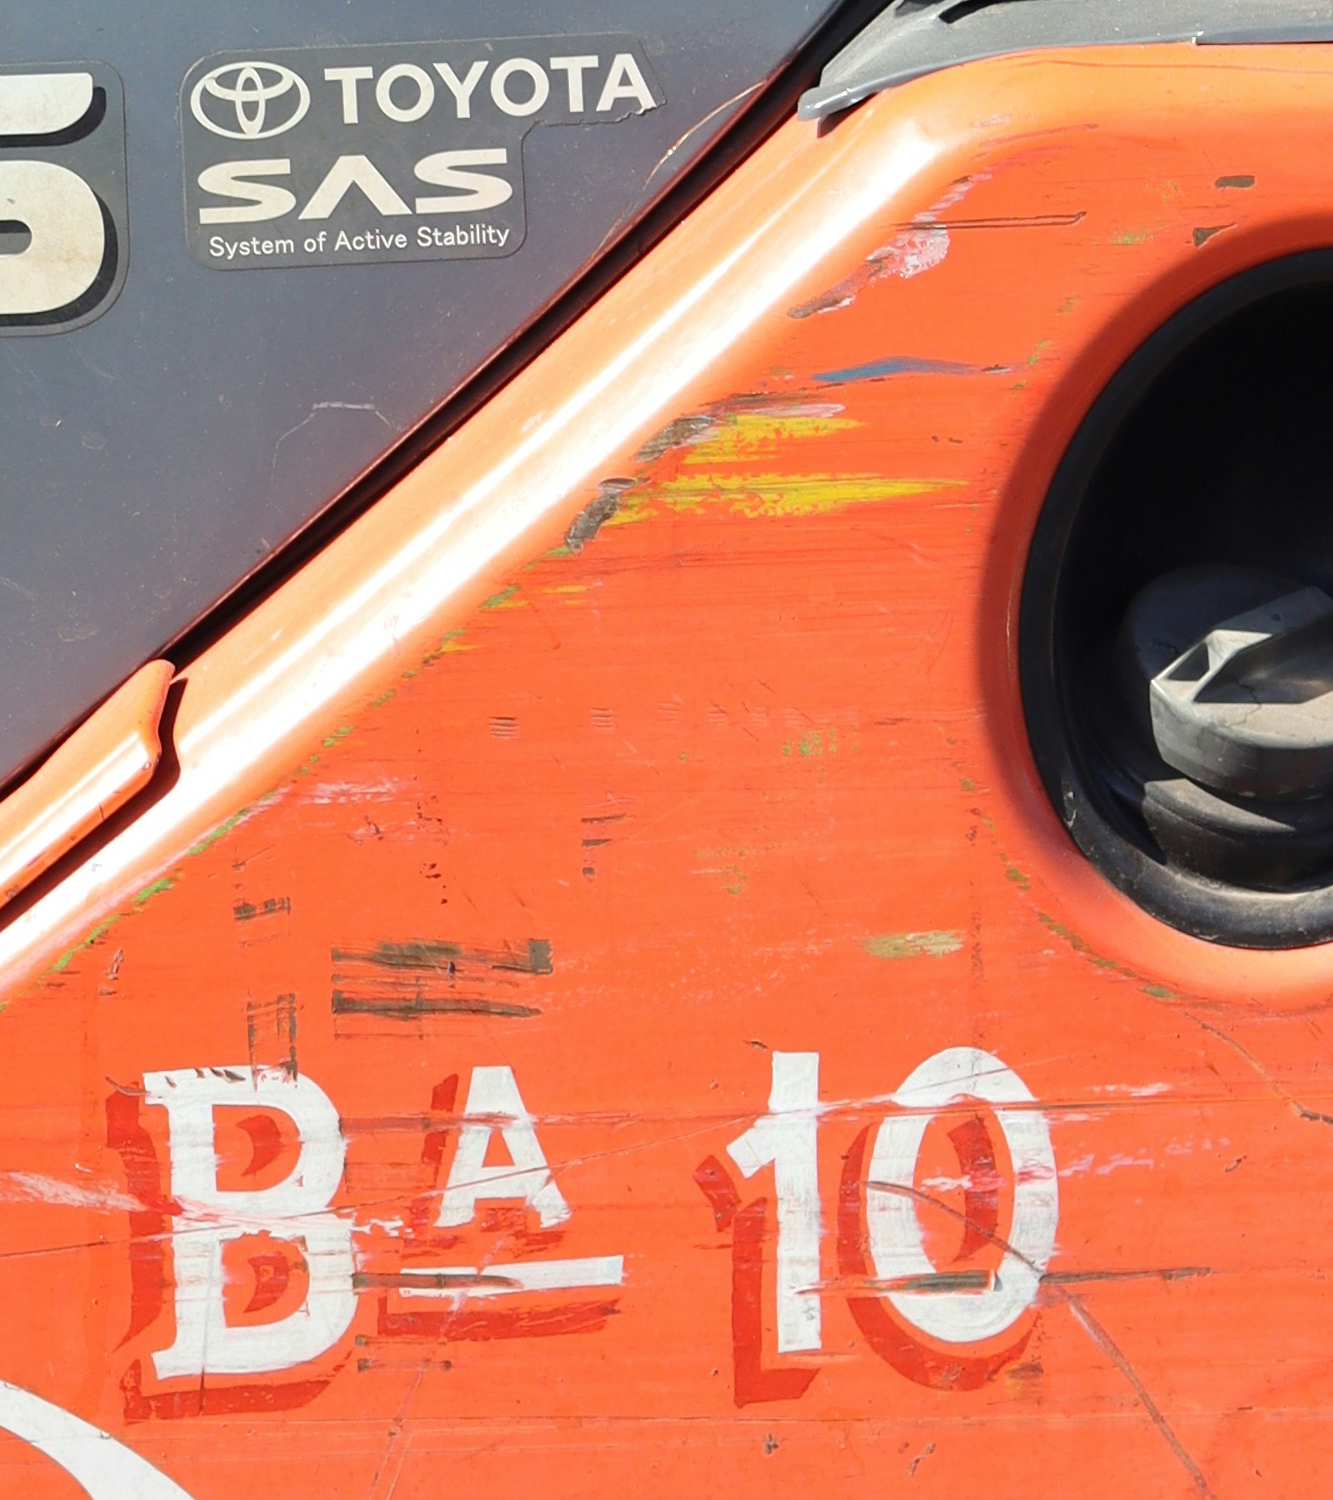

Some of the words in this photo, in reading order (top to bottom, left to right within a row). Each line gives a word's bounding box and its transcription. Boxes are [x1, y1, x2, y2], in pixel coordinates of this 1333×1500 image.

[324, 53, 658, 124] TOYOTA
[197, 148, 513, 225] SAS
[209, 235, 295, 261] System
[303, 230, 328, 254] of
[333, 229, 409, 253] Active
[416, 223, 511, 249] Stability
[725, 1045, 1062, 1355] 10
